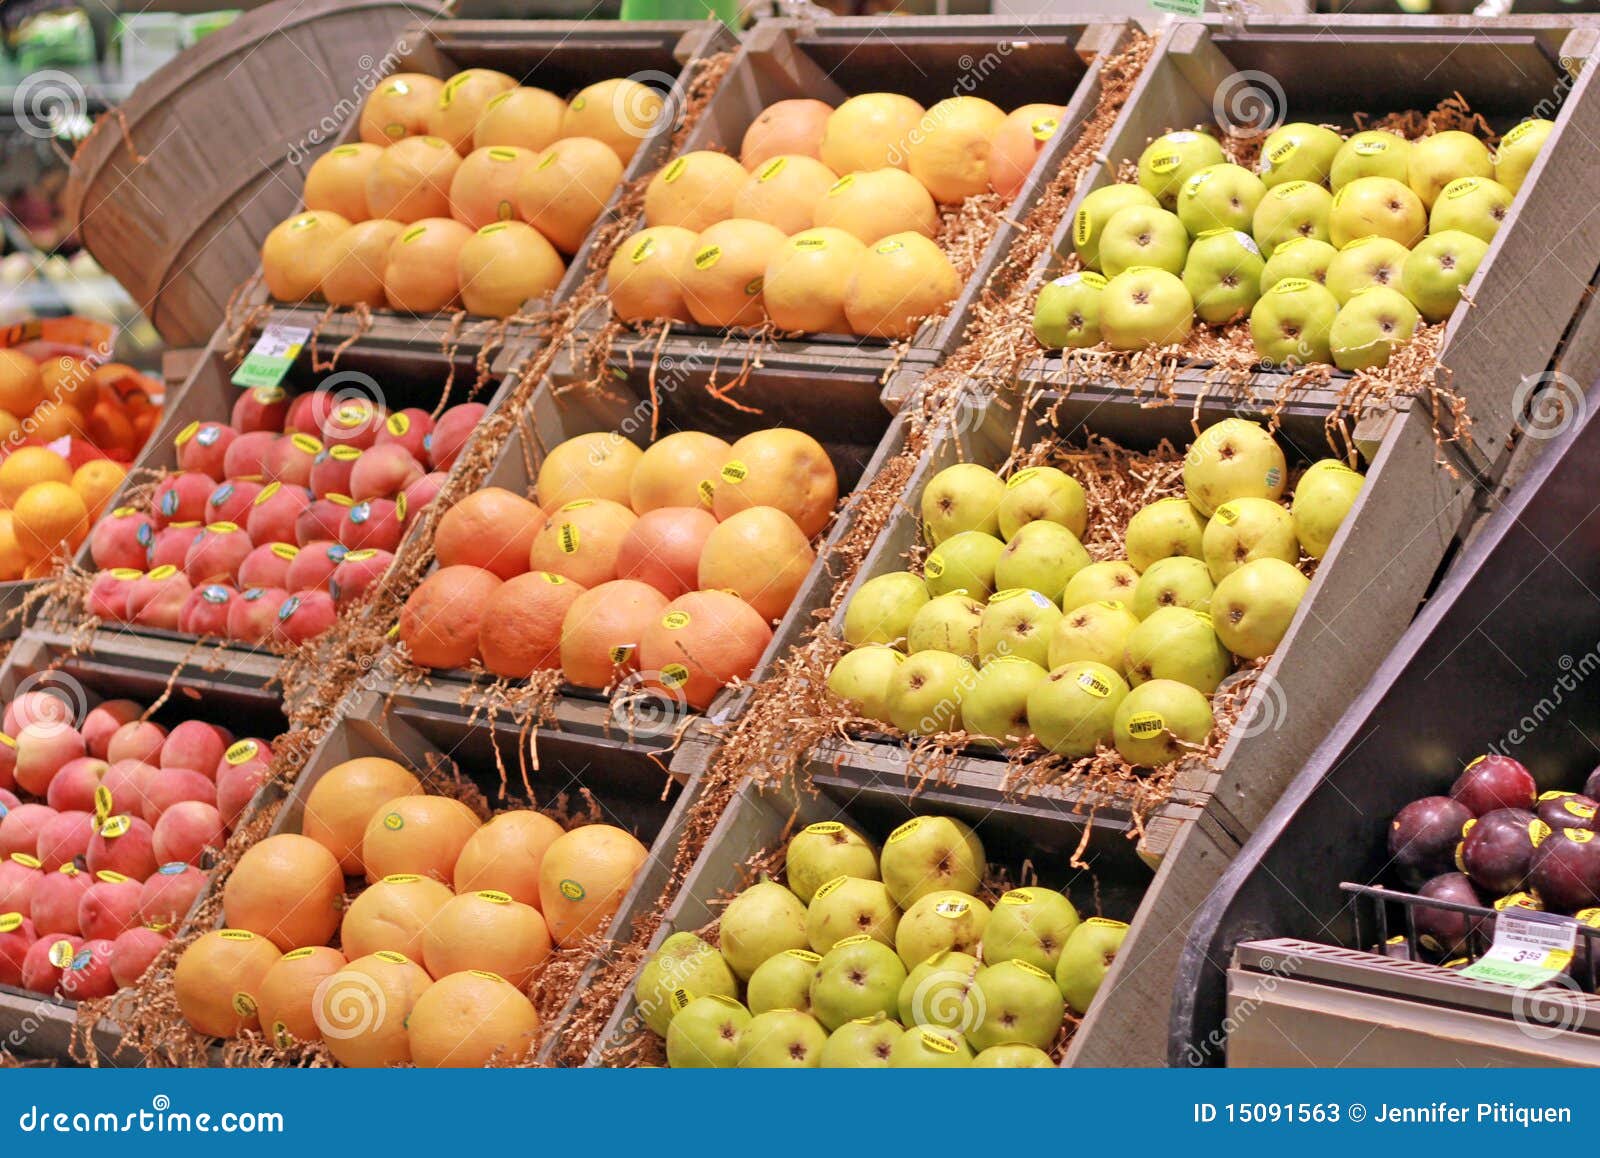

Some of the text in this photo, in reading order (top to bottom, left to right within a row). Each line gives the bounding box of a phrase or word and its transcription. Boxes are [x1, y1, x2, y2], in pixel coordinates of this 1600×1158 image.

[1079, 211, 1087, 243] ORGANIC
[562, 523, 574, 553] ORGANIC
[1079, 673, 1109, 696] ORGAC
[1129, 718, 1163, 733] ORGANIC
[923, 1033, 955, 1051] ORGANIC
